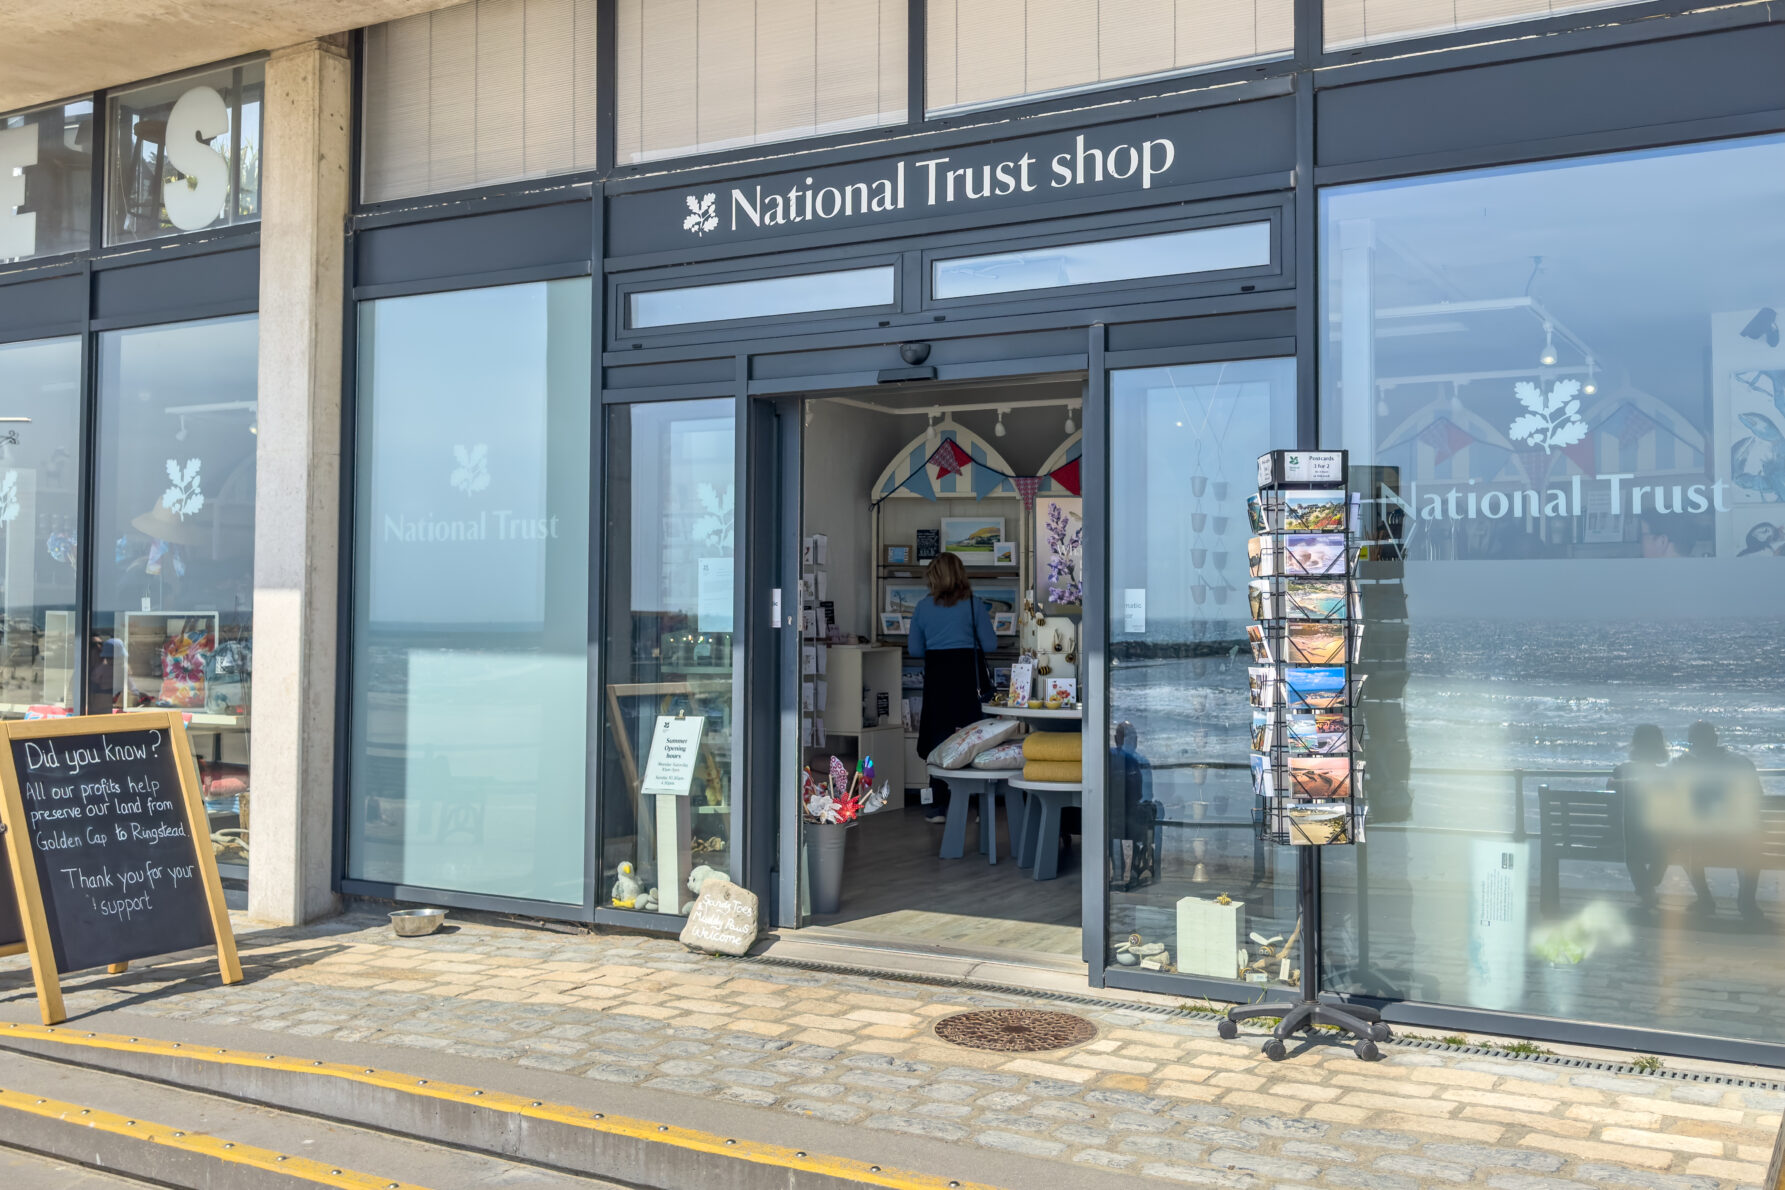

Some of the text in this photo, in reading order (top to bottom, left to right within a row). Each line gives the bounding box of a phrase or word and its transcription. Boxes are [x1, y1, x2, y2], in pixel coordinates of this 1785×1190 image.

[730, 134, 1175, 231] National Trust shop
[1381, 473, 1733, 521] National Trust
[384, 510, 559, 543] National Trust
[25, 740, 59, 770] Did
[66, 746, 101, 774] you
[26, 775, 160, 802] All our profits help
[31, 797, 173, 830] preserve our land from
[36, 821, 190, 851] Golden Cap to Ringstead.
[60, 861, 195, 893] Thank you for your
[101, 890, 152, 922] support
[693, 911, 724, 930] Muddy
[703, 894, 731, 915] Sandy
[691, 926, 742, 945] Welcome
